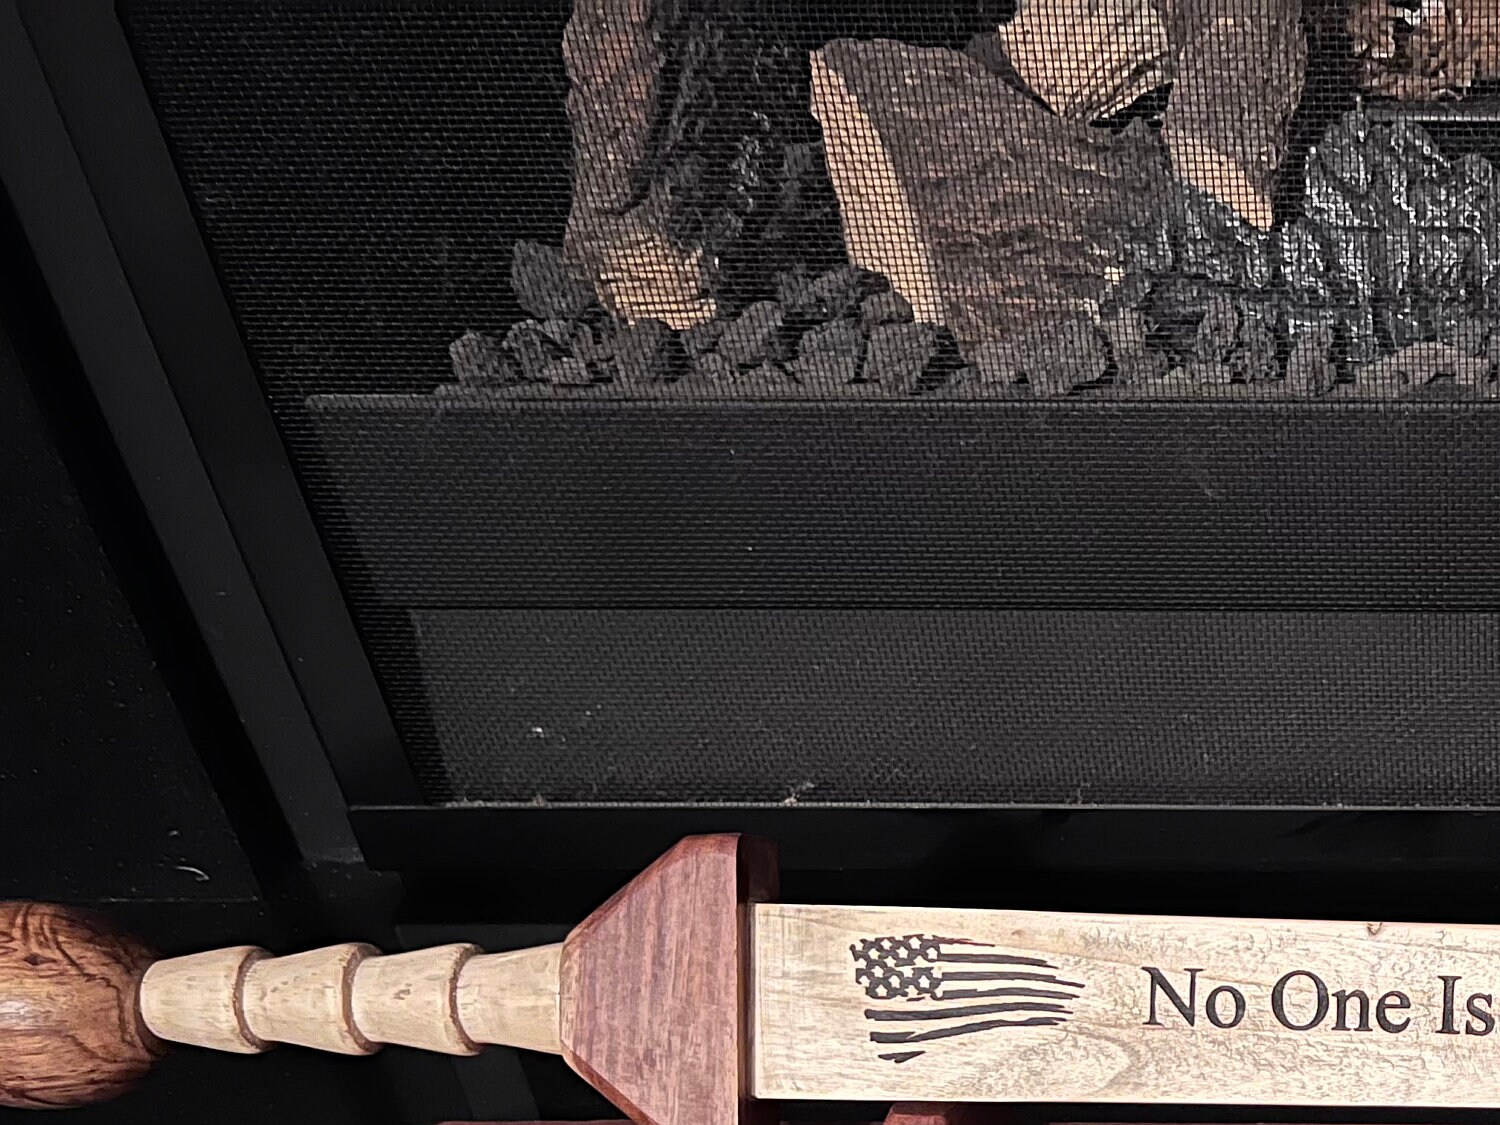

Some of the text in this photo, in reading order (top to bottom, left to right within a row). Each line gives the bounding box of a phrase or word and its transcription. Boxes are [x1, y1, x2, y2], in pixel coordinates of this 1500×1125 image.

[1141, 966, 1246, 1029] No
[1272, 968, 1412, 1034] One
[1435, 975, 1496, 1036] Is
